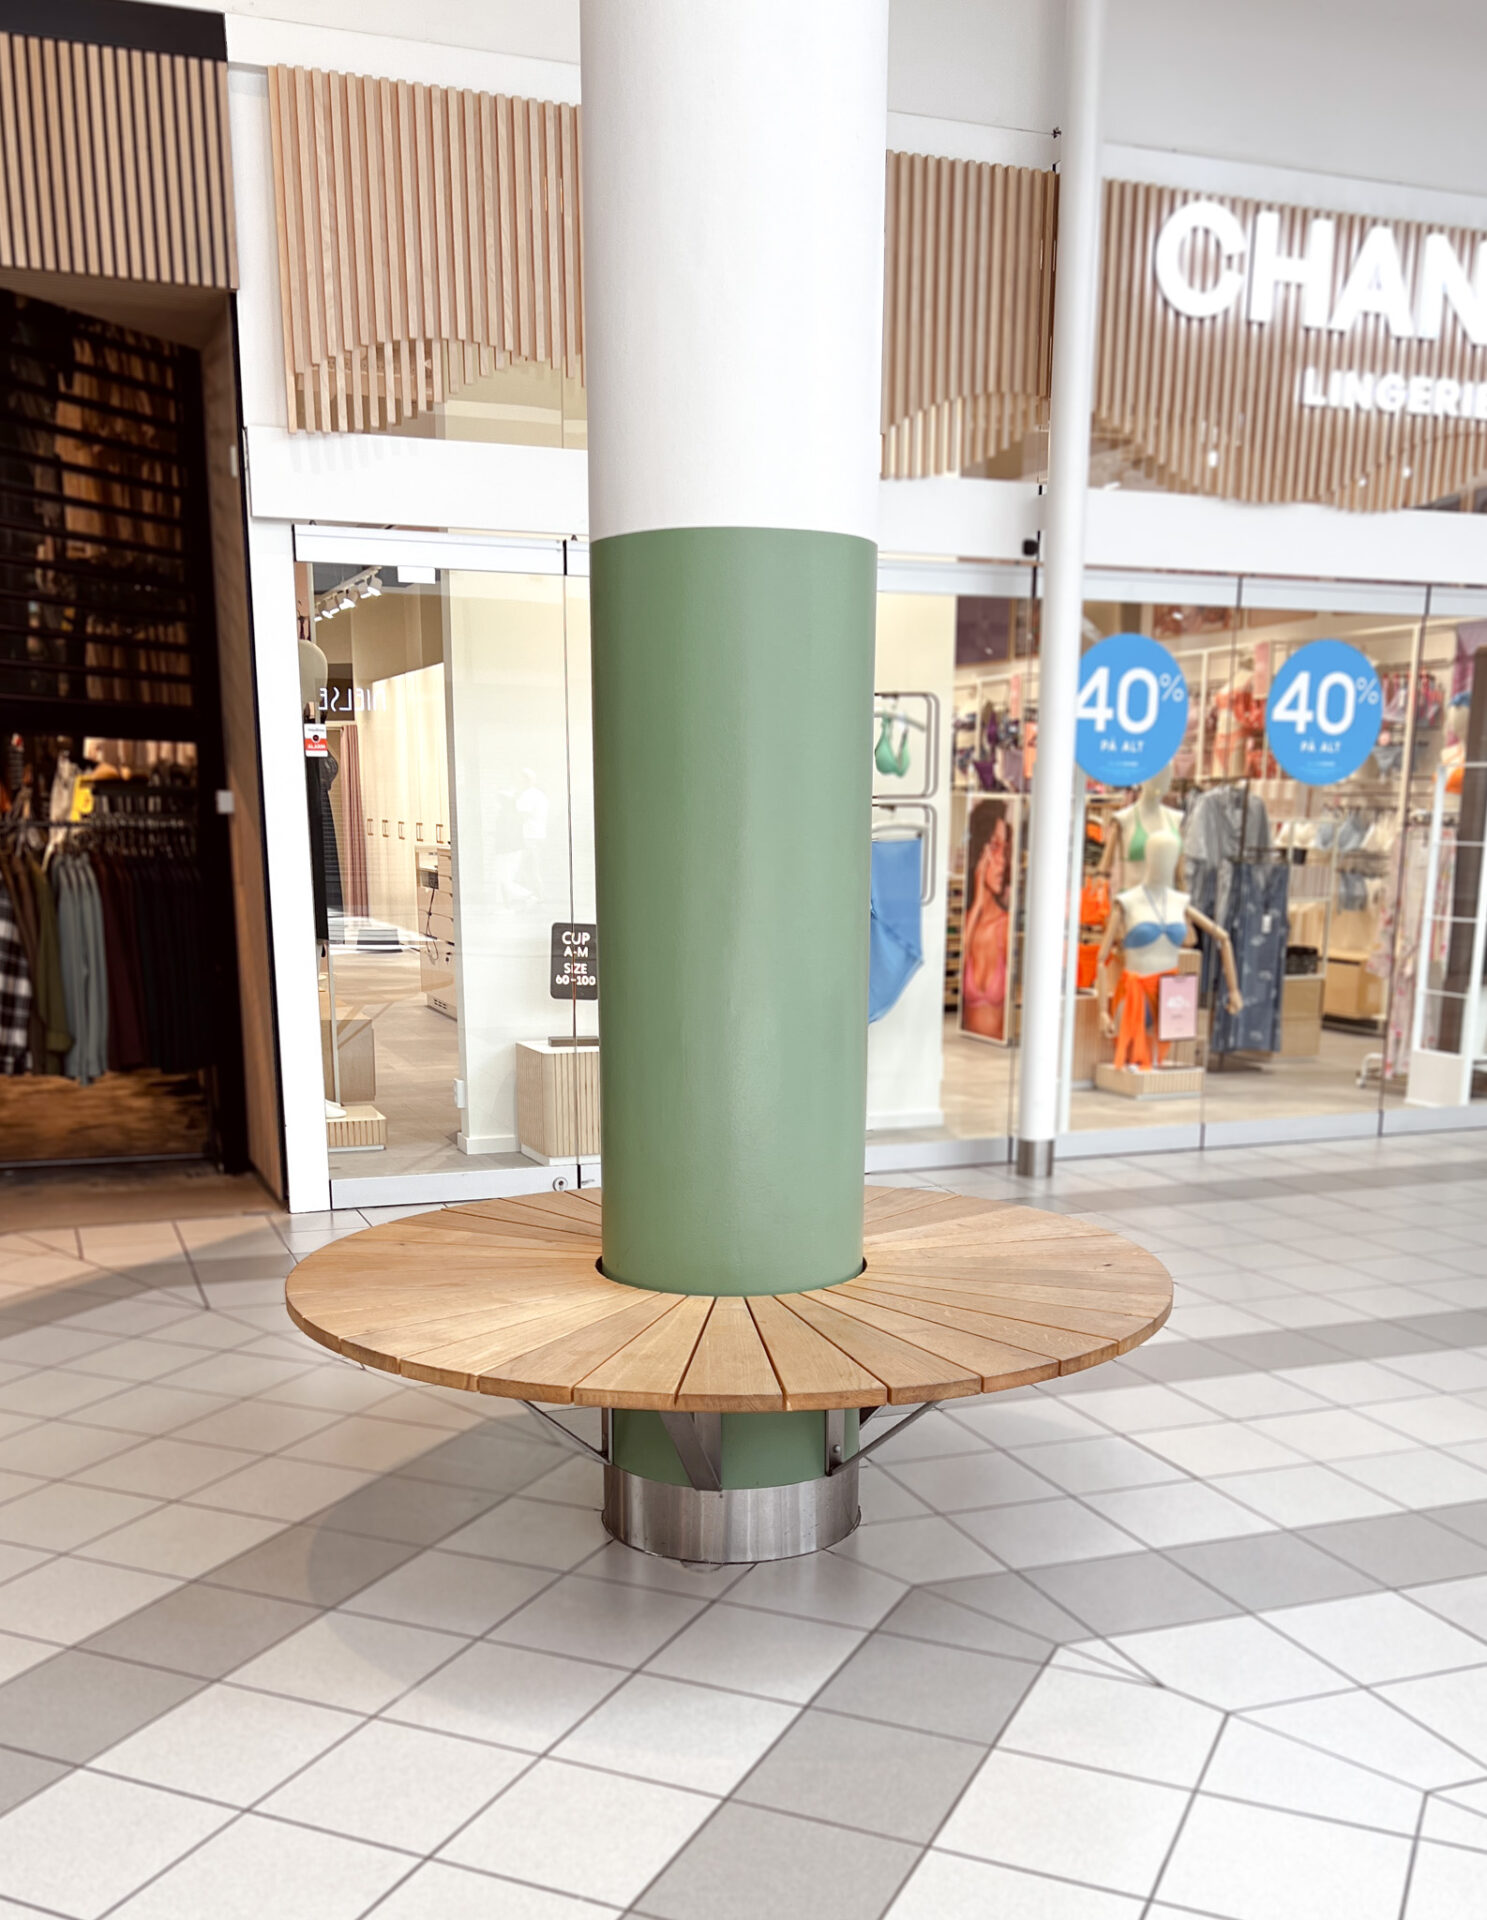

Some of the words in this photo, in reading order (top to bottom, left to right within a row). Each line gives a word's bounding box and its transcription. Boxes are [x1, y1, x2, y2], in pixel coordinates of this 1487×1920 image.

[1155, 199, 1487, 347] CHAN
[1076, 666, 1185, 734] 40%
[1271, 670, 1379, 736] 40%
[562, 930, 590, 946] CUP
[563, 962, 588, 975] SIZE
